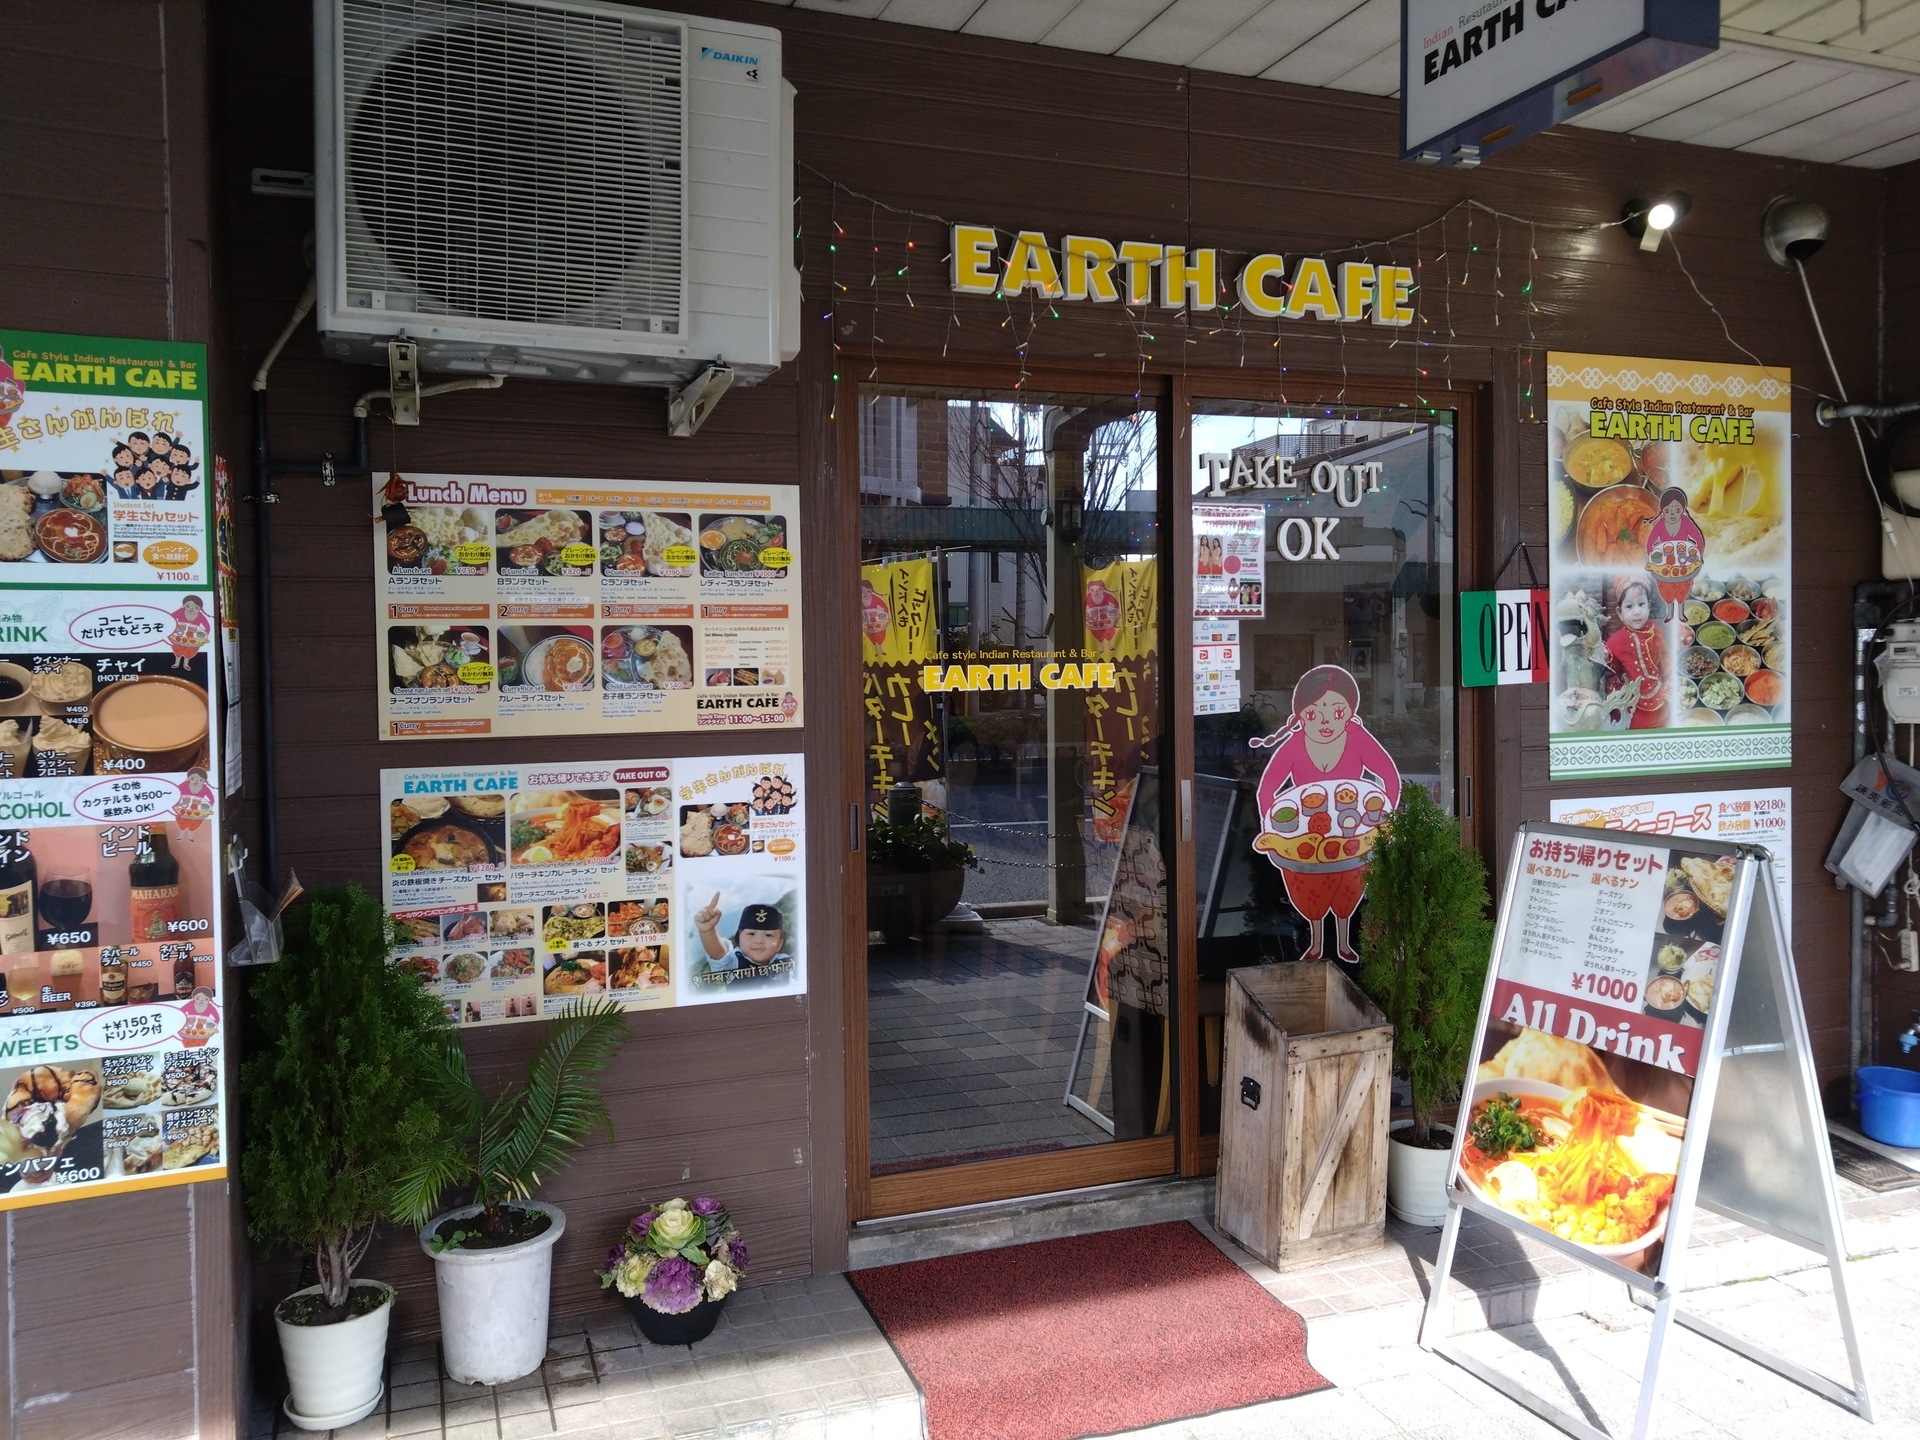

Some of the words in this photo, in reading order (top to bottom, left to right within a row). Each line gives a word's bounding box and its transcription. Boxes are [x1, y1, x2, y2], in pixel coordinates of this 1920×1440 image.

[1423, 25, 1454, 49] Indian
[1424, 0, 1524, 85] EARTH
[713, 51, 759, 66] DAIKIN
[951, 224, 1218, 308] EARTH
[1237, 254, 1415, 326] CAFE
[13, 350, 37, 360] Cafe
[42, 352, 69, 363] Style
[74, 354, 105, 364] Indian
[109, 356, 164, 368] Restaurant
[169, 360, 176, 368] &
[180, 361, 196, 369] Bar
[13, 360, 115, 386] EARTH
[126, 367, 197, 390] CAFE
[1590, 397, 1612, 410] Cafe
[1616, 398, 1641, 413] Style
[1644, 400, 1672, 413] Indian
[1676, 402, 1725, 416] Restaurant
[1728, 405, 1735, 416] &
[1738, 405, 1754, 417] Bar
[1590, 411, 1682, 442] EARTH
[1689, 416, 1754, 444] CAFE
[1199, 452, 1297, 498] TAKE
[1310, 461, 1382, 508] OUT
[406, 482, 464, 504] Lunch
[468, 484, 526, 505] Menu
[113, 510, 199, 522] 学生さんセット
[1277, 516, 1340, 561] OK
[157, 572, 190, 581] ¥1100
[388, 577, 442, 585] Aランチセット
[98, 615, 145, 627] コーヒー
[81, 622, 164, 639] だけでもどうぞ
[1478, 600, 1550, 674] OPEN
[33, 656, 81, 665] ウインナー
[925, 650, 949, 660] Cafe
[952, 650, 977, 661] style
[979, 649, 1009, 659] Indian
[1013, 649, 1066, 659] Restaurant
[1070, 649, 1078, 658] &
[1080, 649, 1097, 658] Bar
[33, 665, 62, 674] チャイ
[96, 657, 146, 673] チャイ
[923, 663, 1031, 692] EARTH
[1040, 662, 1116, 690] CAFE
[390, 696, 475, 704] チーズナンランチセット
[499, 694, 565, 702] カレーライスセット
[602, 692, 666, 700] お子様ランチセット
[697, 699, 742, 709] EARTH
[747, 698, 779, 707] CAFE
[37, 759, 76, 768] ラッシー
[103, 758, 146, 771] ¥400
[37, 768, 75, 776] フロート
[528, 771, 610, 785] お持ち帰りできます
[615, 772, 636, 780] TAKE
[637, 771, 654, 780] OUT
[655, 770, 667, 778] OK
[112, 781, 141, 792] その他
[404, 779, 466, 794] EARTH
[473, 777, 518, 791] CAFE
[679, 762, 786, 800] 学生さんがんばれ
[82, 793, 131, 808] カクテルも
[1718, 801, 1751, 813] 食べ放題
[1754, 799, 1783, 811] ¥2180
[103, 806, 133, 818] 昼飲み
[135, 804, 155, 813] OK!
[1718, 819, 1751, 832] 飲み放題
[1754, 817, 1783, 829] ¥1000
[100, 824, 151, 843] インド
[101, 842, 152, 858] ビール
[1529, 838, 1663, 875] お持ち帰りセット
[510, 867, 597, 879] バターチキンカレーラーメン
[1526, 863, 1579, 879] 選べるカレー
[392, 876, 481, 887] 炎の鉄板焼きチーズカレー
[1532, 879, 1566, 889] 日替わりカレー
[1591, 872, 1639, 889] 選べるナン
[510, 888, 587, 898] バターチキンカレーラーメン
[1531, 887, 1560, 896] チキンカレー
[1598, 890, 1624, 899] チーズナン
[1529, 895, 1558, 905] マトンカレー
[1596, 899, 1632, 910] ガーリックナン
[1528, 904, 1557, 913] キーマカレー
[1595, 907, 1615, 916] ごまナン
[1526, 912, 1564, 924] ベジタブルカレー
[167, 919, 208, 932] ¥600
[1525, 921, 1562, 932] シーフードカレー
[1591, 925, 1616, 935] くるみナン
[46, 931, 92, 945] ¥650
[1523, 929, 1575, 944] ほうれん草チキンカレー
[1589, 933, 1615, 944] あんこナン
[160, 942, 194, 953] ネパール
[1521, 938, 1559, 950] バターえびカレー
[1587, 943, 1624, 955] マサラクルチャ
[101, 947, 139, 957] ネパール
[161, 952, 188, 961] ビール
[1520, 946, 1562, 959] バターチキンカレー
[1586, 951, 1618, 963] プレーンナン
[101, 957, 121, 967] ラム
[702, 970, 731, 983] नम्बर
[772, 958, 796, 974] फोटो
[1584, 960, 1637, 977] ほうれん草キーマナン
[1571, 972, 1638, 1003] ¥1000
[42, 993, 71, 1003] BEER
[12, 1006, 35, 1014] ¥500
[75, 1000, 97, 1009] ¥390
[102, 1015, 148, 1032] +¥150
[151, 1013, 162, 1023] で
[12, 1026, 52, 1037] スイーツ
[105, 1023, 163, 1043] ドリンク付
[1501, 993, 1557, 1036] All
[1564, 1009, 1686, 1075] Drink
[164, 1048, 219, 1061] チョコレートナン
[104, 1055, 154, 1067] キャラメルナン
[165, 1058, 212, 1070] アイスプレート
[104, 1064, 154, 1076] アイスプレート
[106, 1078, 128, 1087] ¥500
[166, 1109, 214, 1121] 焼きリンゴナン
[105, 1118, 141, 1129] あんこナン
[166, 1118, 214, 1129] アイスプレート
[106, 1125, 154, 1137] アイスプレート
[0, 1157, 75, 1177] ンパフェ
[56, 1166, 100, 1183] ¥600
